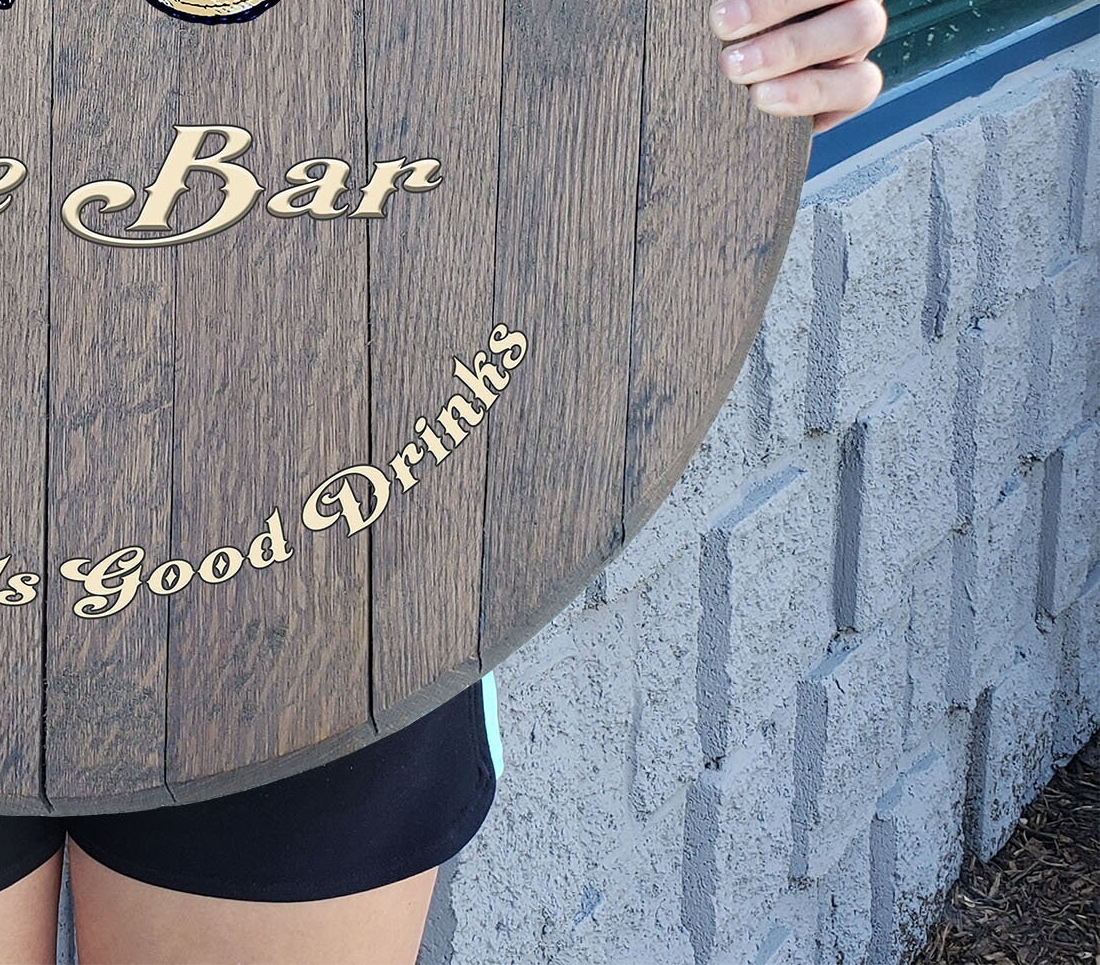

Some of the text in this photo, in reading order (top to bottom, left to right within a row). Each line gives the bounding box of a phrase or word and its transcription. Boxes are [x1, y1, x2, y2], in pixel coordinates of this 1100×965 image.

[60, 124, 442, 248] Bar
[60, 507, 292, 619] Good
[301, 322, 528, 537] Drinks
